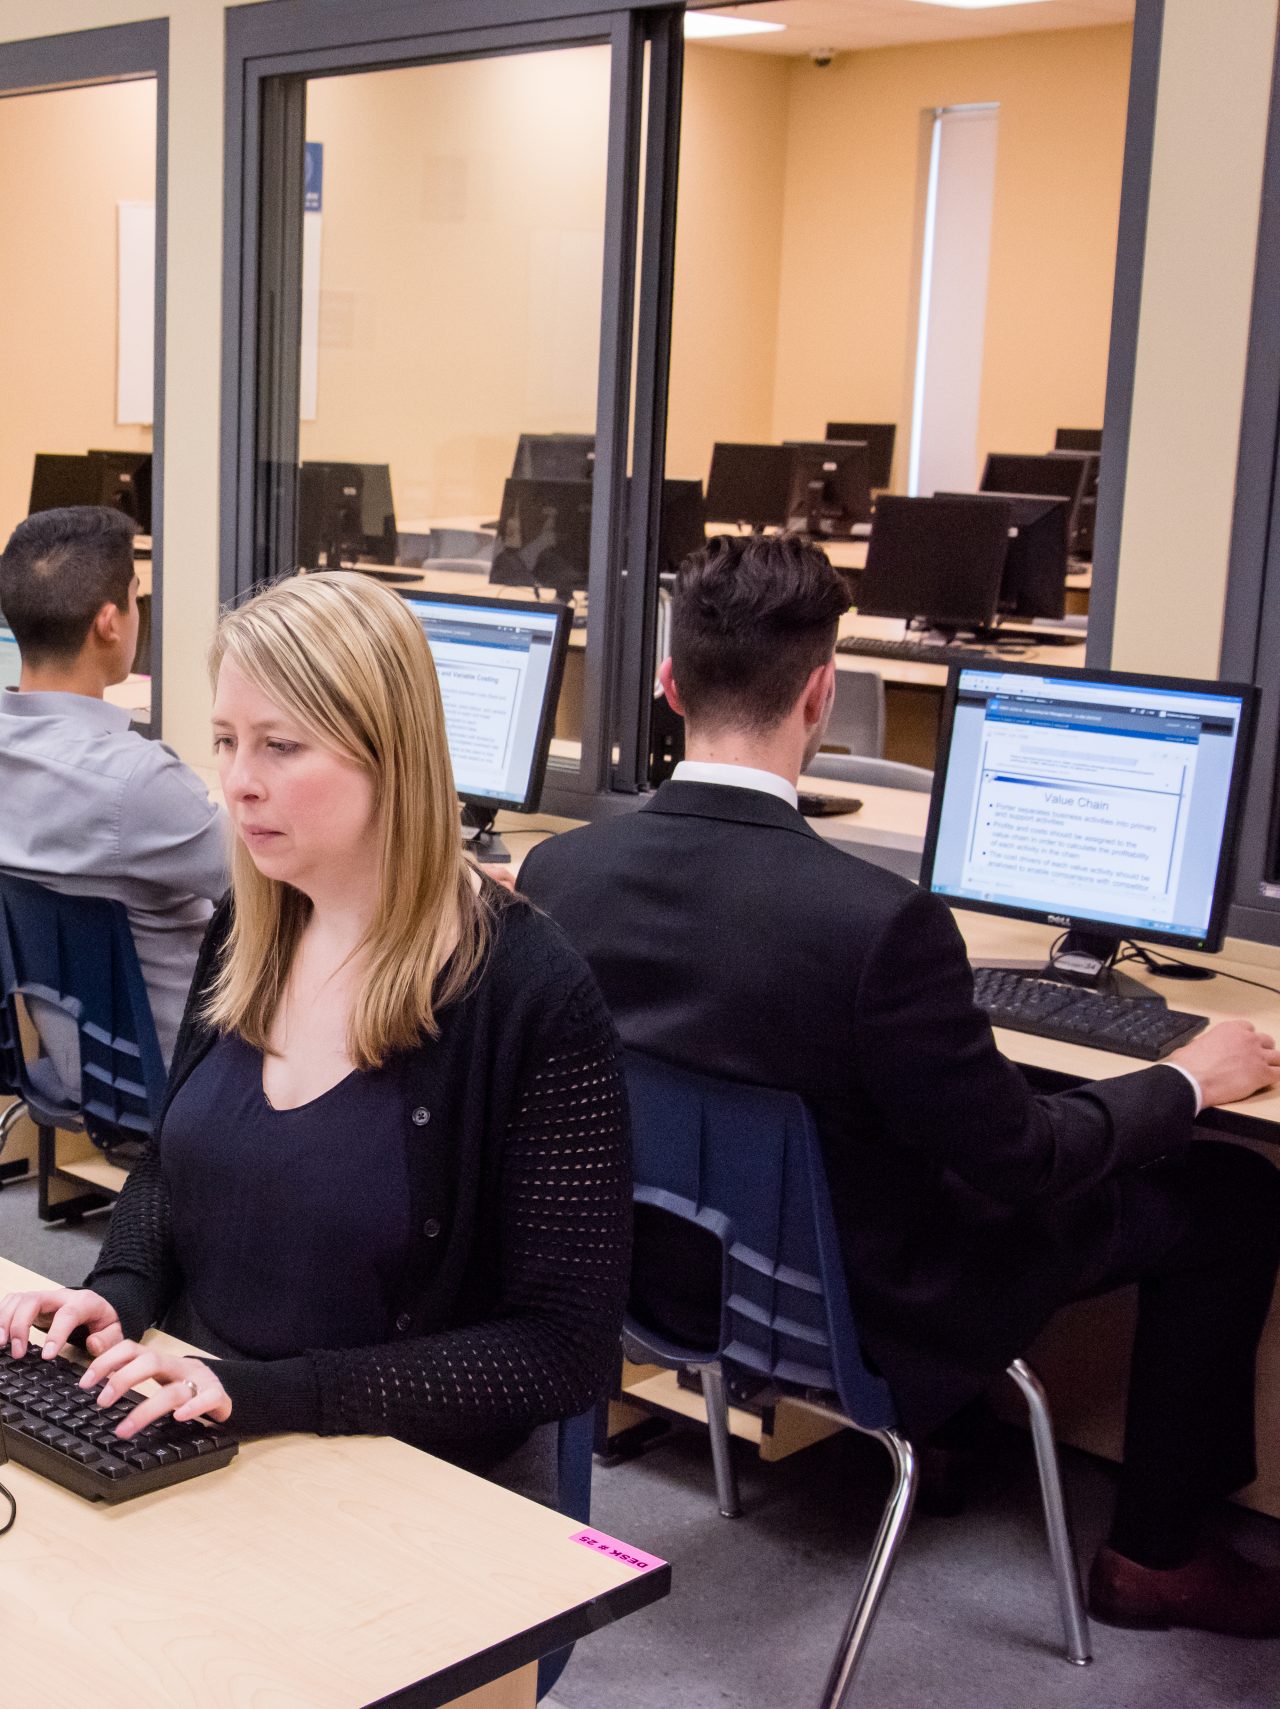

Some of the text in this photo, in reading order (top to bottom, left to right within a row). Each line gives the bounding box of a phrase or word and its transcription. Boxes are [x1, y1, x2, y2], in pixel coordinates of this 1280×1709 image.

[1044, 792, 1109, 811] Value Chain
[1048, 915, 1072, 926] DELL
[579, 1536, 598, 1545] 25
[610, 1550, 648, 1568] DESK
